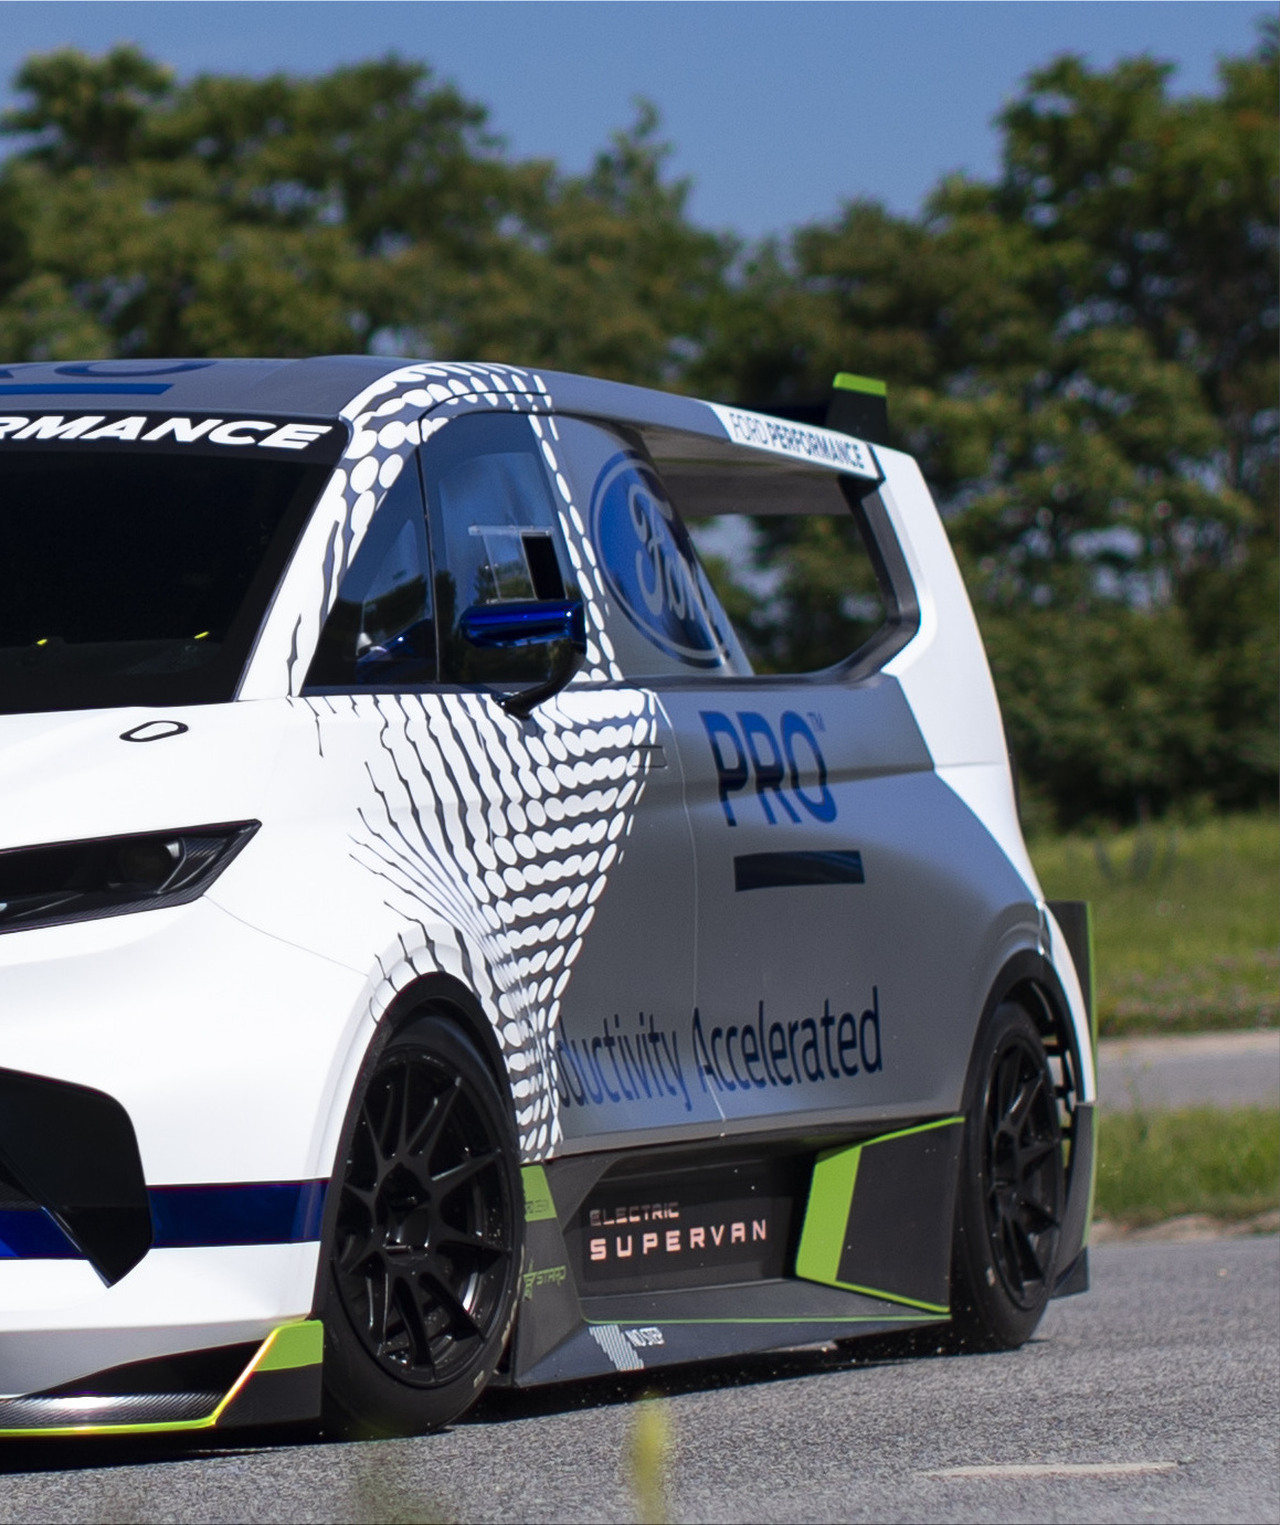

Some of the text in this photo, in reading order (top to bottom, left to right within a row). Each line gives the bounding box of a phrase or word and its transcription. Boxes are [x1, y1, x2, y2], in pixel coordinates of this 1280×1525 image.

[729, 412, 865, 470] FORD PERFORMANCE
[699, 710, 837, 827] PRO
[693, 985, 883, 1093] Accelerated
[589, 1202, 680, 1226] ELECTRIC
[590, 1219, 767, 1261] SUPERVAN
